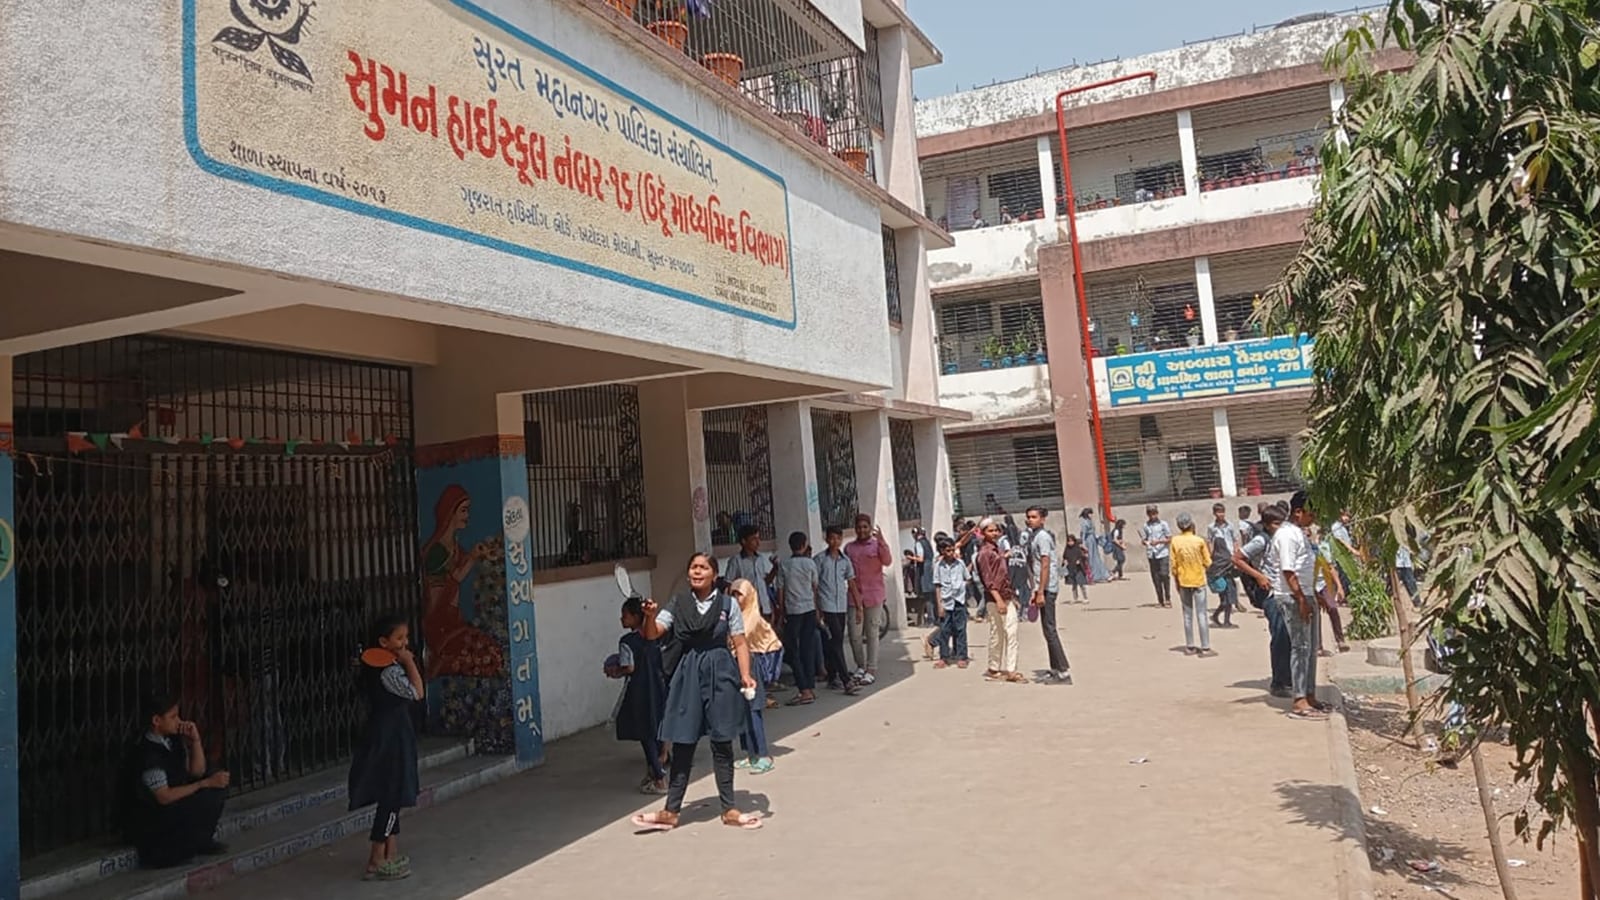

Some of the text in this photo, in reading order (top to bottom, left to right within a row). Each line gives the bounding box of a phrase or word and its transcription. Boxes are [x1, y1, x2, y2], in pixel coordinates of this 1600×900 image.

[472, 36, 527, 93] સુરત
[534, 68, 611, 132] મહાનગર
[614, 105, 665, 159] પાલિકા
[228, 140, 264, 168] શાળા
[267, 154, 318, 185] સ્થાપના
[344, 50, 438, 141] સુમન
[447, 95, 548, 187] હાઈસ્કૂલ
[670, 192, 738, 253] માધ્યમિક
[739, 209, 789, 279] વિભાગ)
[459, 186, 505, 214] ગુજરાત
[1134, 361, 1157, 376] શ્રી
[1233, 347, 1300, 364] તૈયબજી
